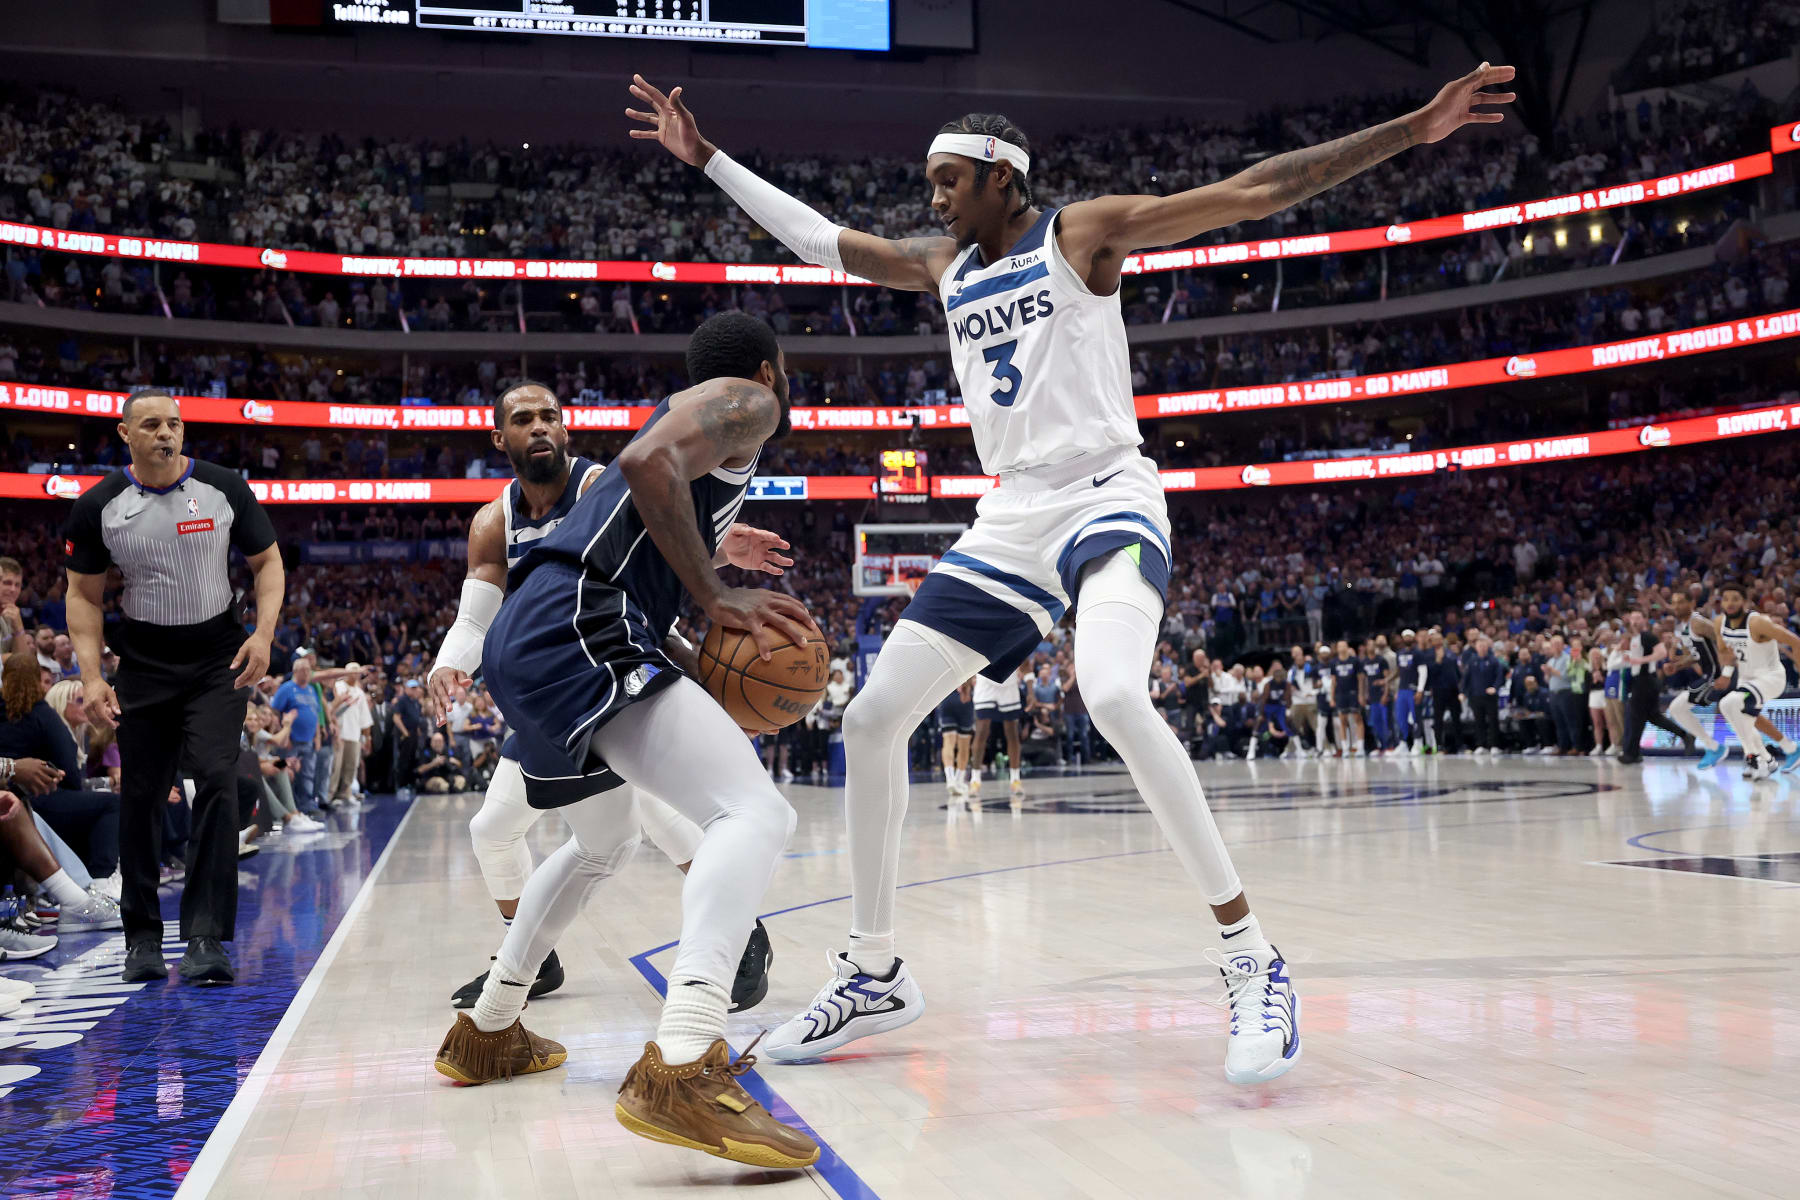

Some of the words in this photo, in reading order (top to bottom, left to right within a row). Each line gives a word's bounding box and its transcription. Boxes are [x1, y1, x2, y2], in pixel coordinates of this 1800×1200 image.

[500, 18, 535, 30] YOUR
[1525, 196, 1581, 219] PROUD
[1599, 185, 1644, 206] LOUD
[1657, 177, 1679, 196] GO
[1682, 164, 1735, 190] MAVS!
[58, 233, 104, 252] LOUD
[119, 239, 142, 256] GO
[145, 241, 199, 260] MAVS!
[404, 259, 457, 275] PROUD
[474, 261, 515, 276] LOUD
[549, 262, 597, 278] MAVS!
[953, 290, 1054, 346] WOLVES
[1592, 338, 1664, 366] ROWDY,
[1667, 326, 1733, 353] PROUD
[982, 339, 1023, 407] 3
[15, 387, 68, 409] LOUD
[86, 394, 112, 412] GO
[1158, 392, 1223, 413] ROWDY,
[1226, 387, 1284, 407] PROUD
[1304, 381, 1351, 401] LOUD
[1366, 377, 1389, 395] GO
[1392, 369, 1448, 392] MAVS!
[329, 407, 399, 428] ROWDY,
[403, 409, 464, 426] PROUD
[574, 410, 629, 426] MAVS!
[817, 410, 873, 426] PROUD
[1717, 410, 1787, 435] ROWDY,
[1313, 459, 1376, 479] ROWDY,
[1378, 454, 1434, 474] PROUD
[1508, 444, 1531, 461] GO
[1534, 437, 1589, 458] MAVS!
[288, 483, 335, 500] LOUD
[349, 483, 373, 499] GO
[375, 483, 431, 499] MAVS!
[180, 522, 211, 532] Emirates
